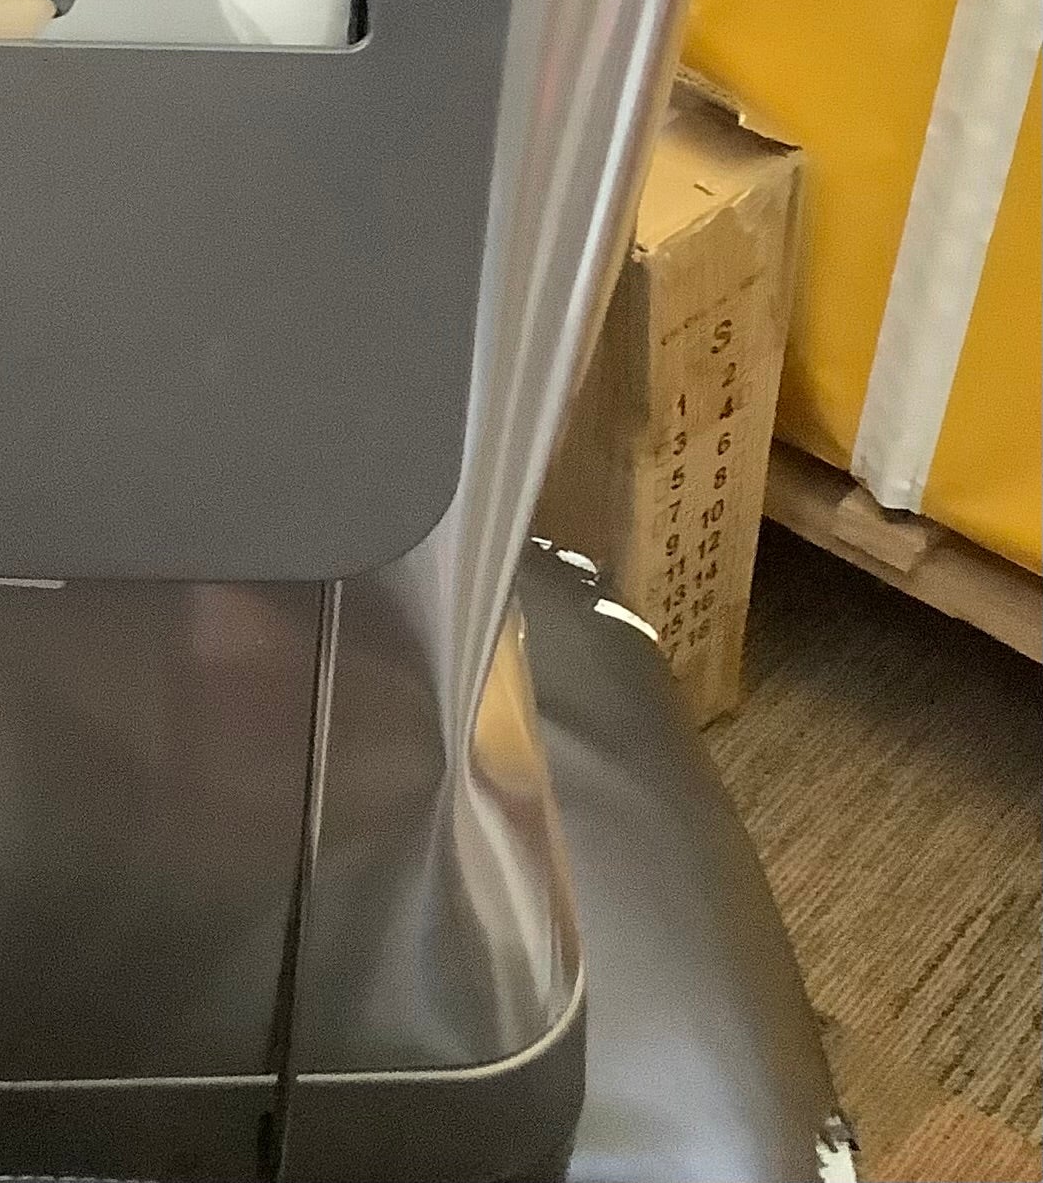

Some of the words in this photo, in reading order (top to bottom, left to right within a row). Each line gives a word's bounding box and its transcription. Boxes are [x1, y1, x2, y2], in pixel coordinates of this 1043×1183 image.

[677, 393, 686, 417] 1
[673, 431, 687, 456] 3
[717, 431, 731, 456] 6
[670, 463, 685, 490] 5
[713, 466, 727, 490] 8
[668, 498, 682, 523] 7
[701, 498, 725, 529] 10
[665, 533, 679, 557] 9
[698, 529, 720, 559] 12
[663, 556, 685, 583] 11
